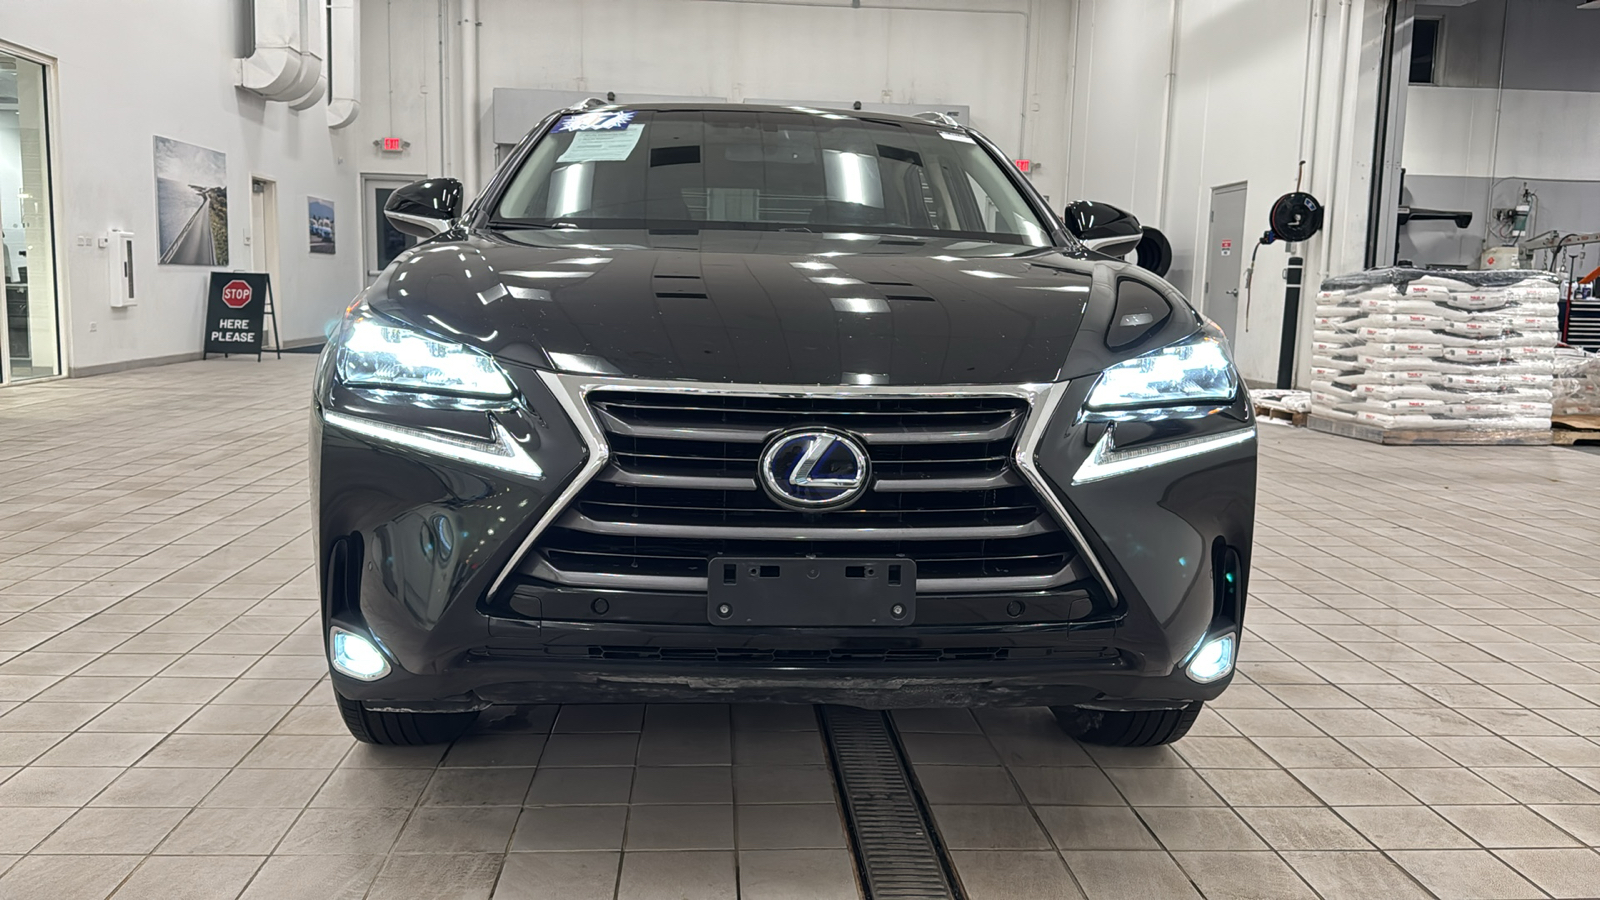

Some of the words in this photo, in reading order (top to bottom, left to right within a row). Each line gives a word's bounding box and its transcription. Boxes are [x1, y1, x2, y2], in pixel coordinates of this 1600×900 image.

[224, 289, 250, 299] STOP
[219, 318, 249, 329] HERE
[211, 331, 255, 342] PLEASE
